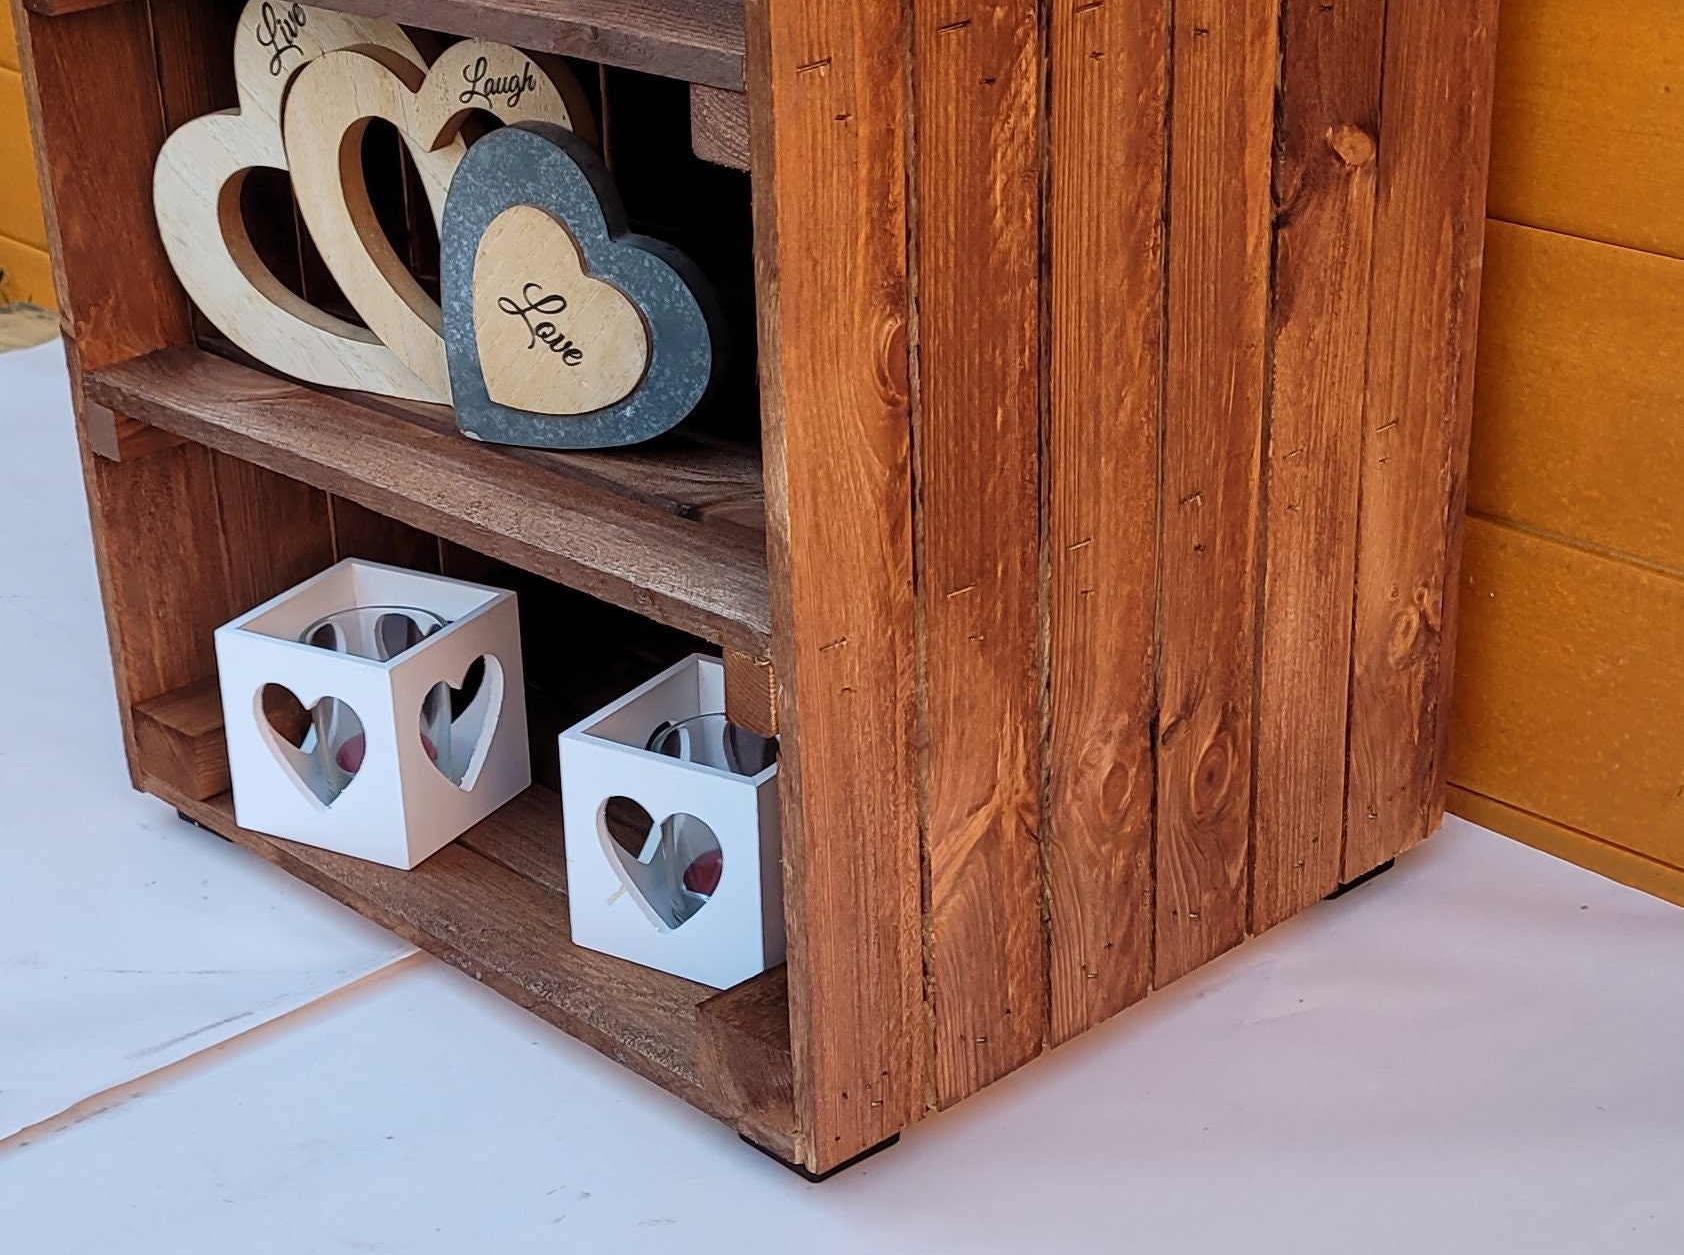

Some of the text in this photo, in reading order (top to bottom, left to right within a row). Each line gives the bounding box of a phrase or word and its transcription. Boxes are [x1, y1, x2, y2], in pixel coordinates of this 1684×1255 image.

[256, 2, 307, 77] Live
[458, 56, 537, 109] Laugh
[497, 282, 584, 367] Love
